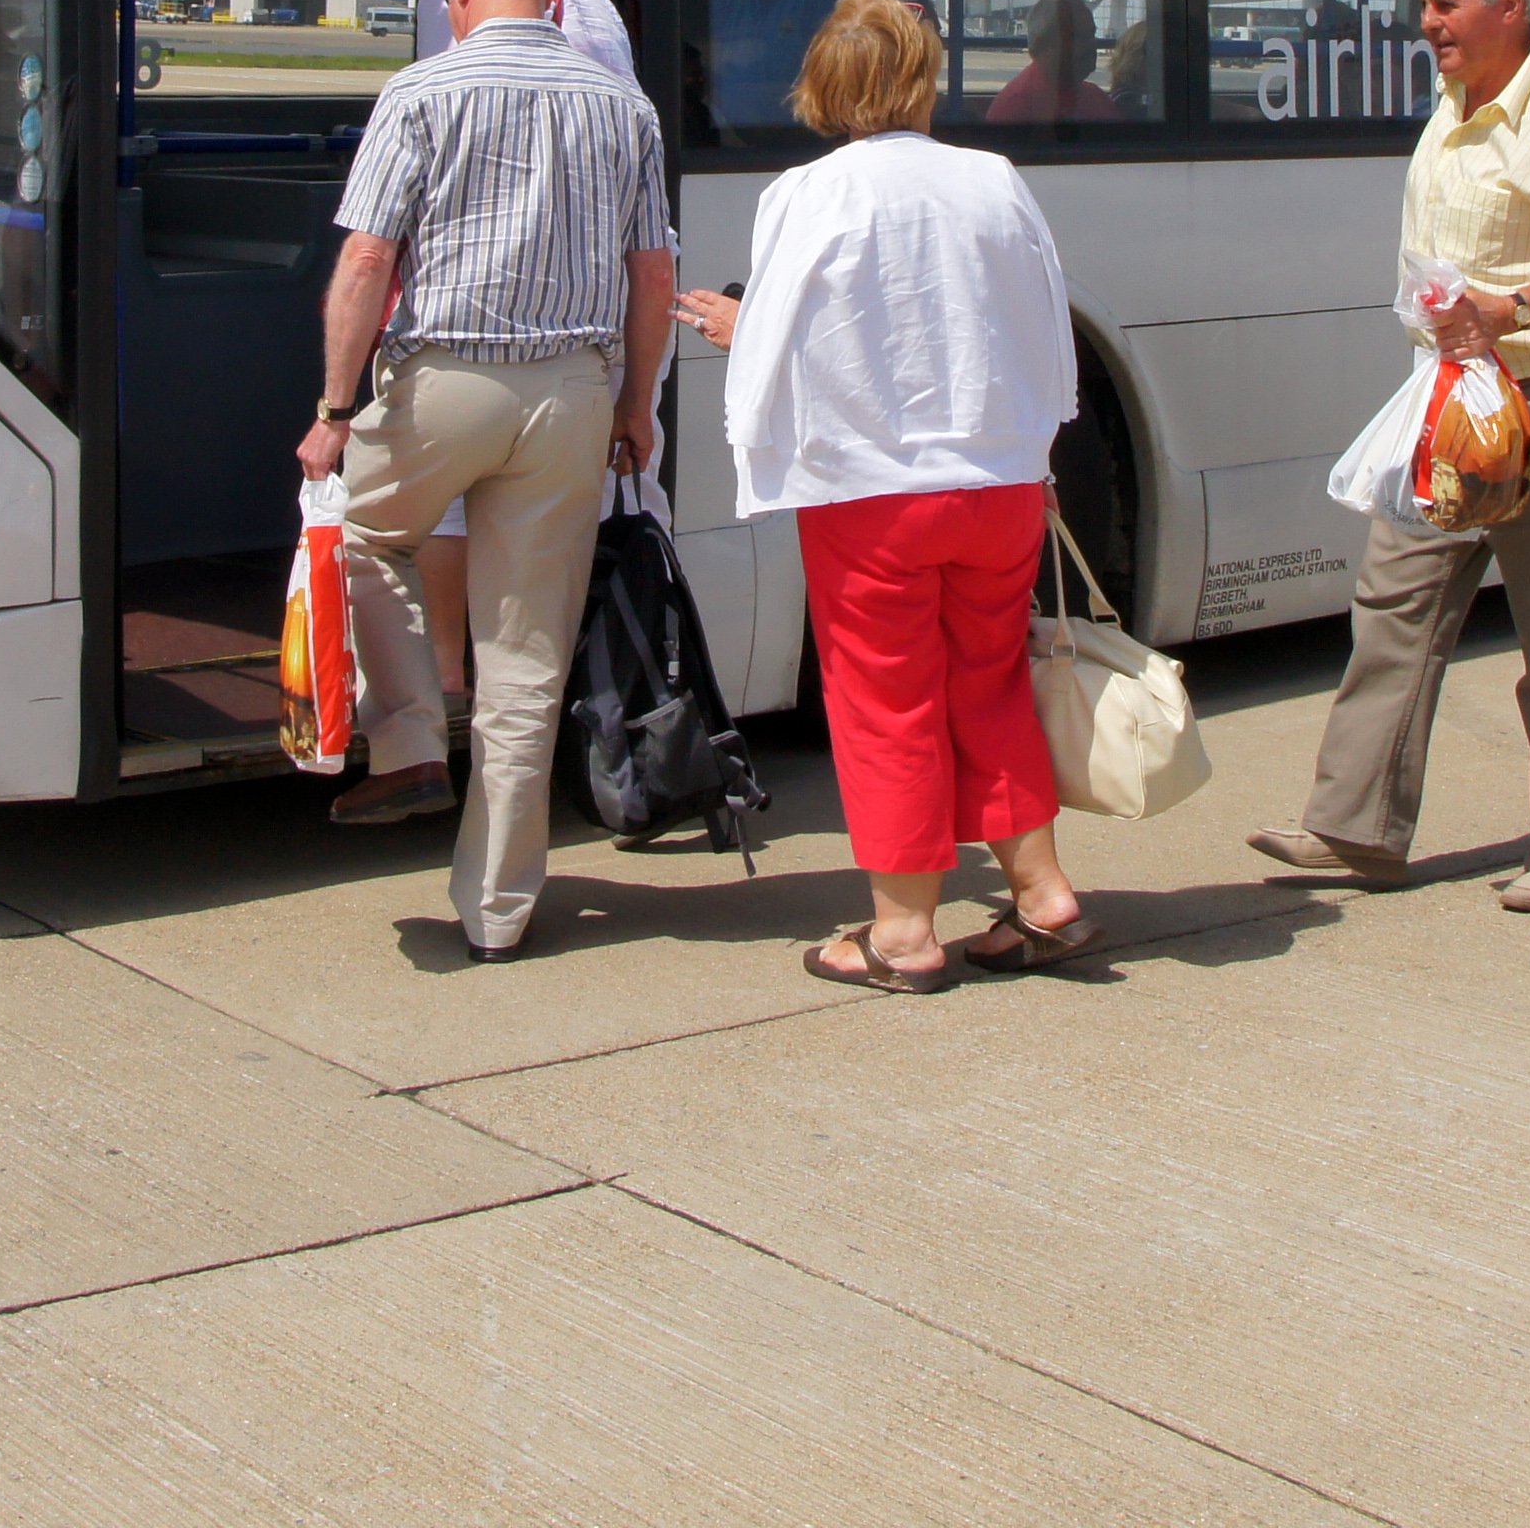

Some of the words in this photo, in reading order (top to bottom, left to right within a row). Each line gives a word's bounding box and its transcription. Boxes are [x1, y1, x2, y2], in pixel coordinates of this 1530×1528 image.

[1257, 4, 1439, 122] airlin
[1207, 560, 1255, 577] NATIONAL
[1258, 551, 1303, 570] EXPRESS
[1305, 548, 1322, 562] LTD
[1206, 572, 1269, 591] BIRMINGHAM
[1271, 566, 1305, 581] COACH
[1198, 624, 1211, 637] B5
[1213, 620, 1233, 634] 6DD
